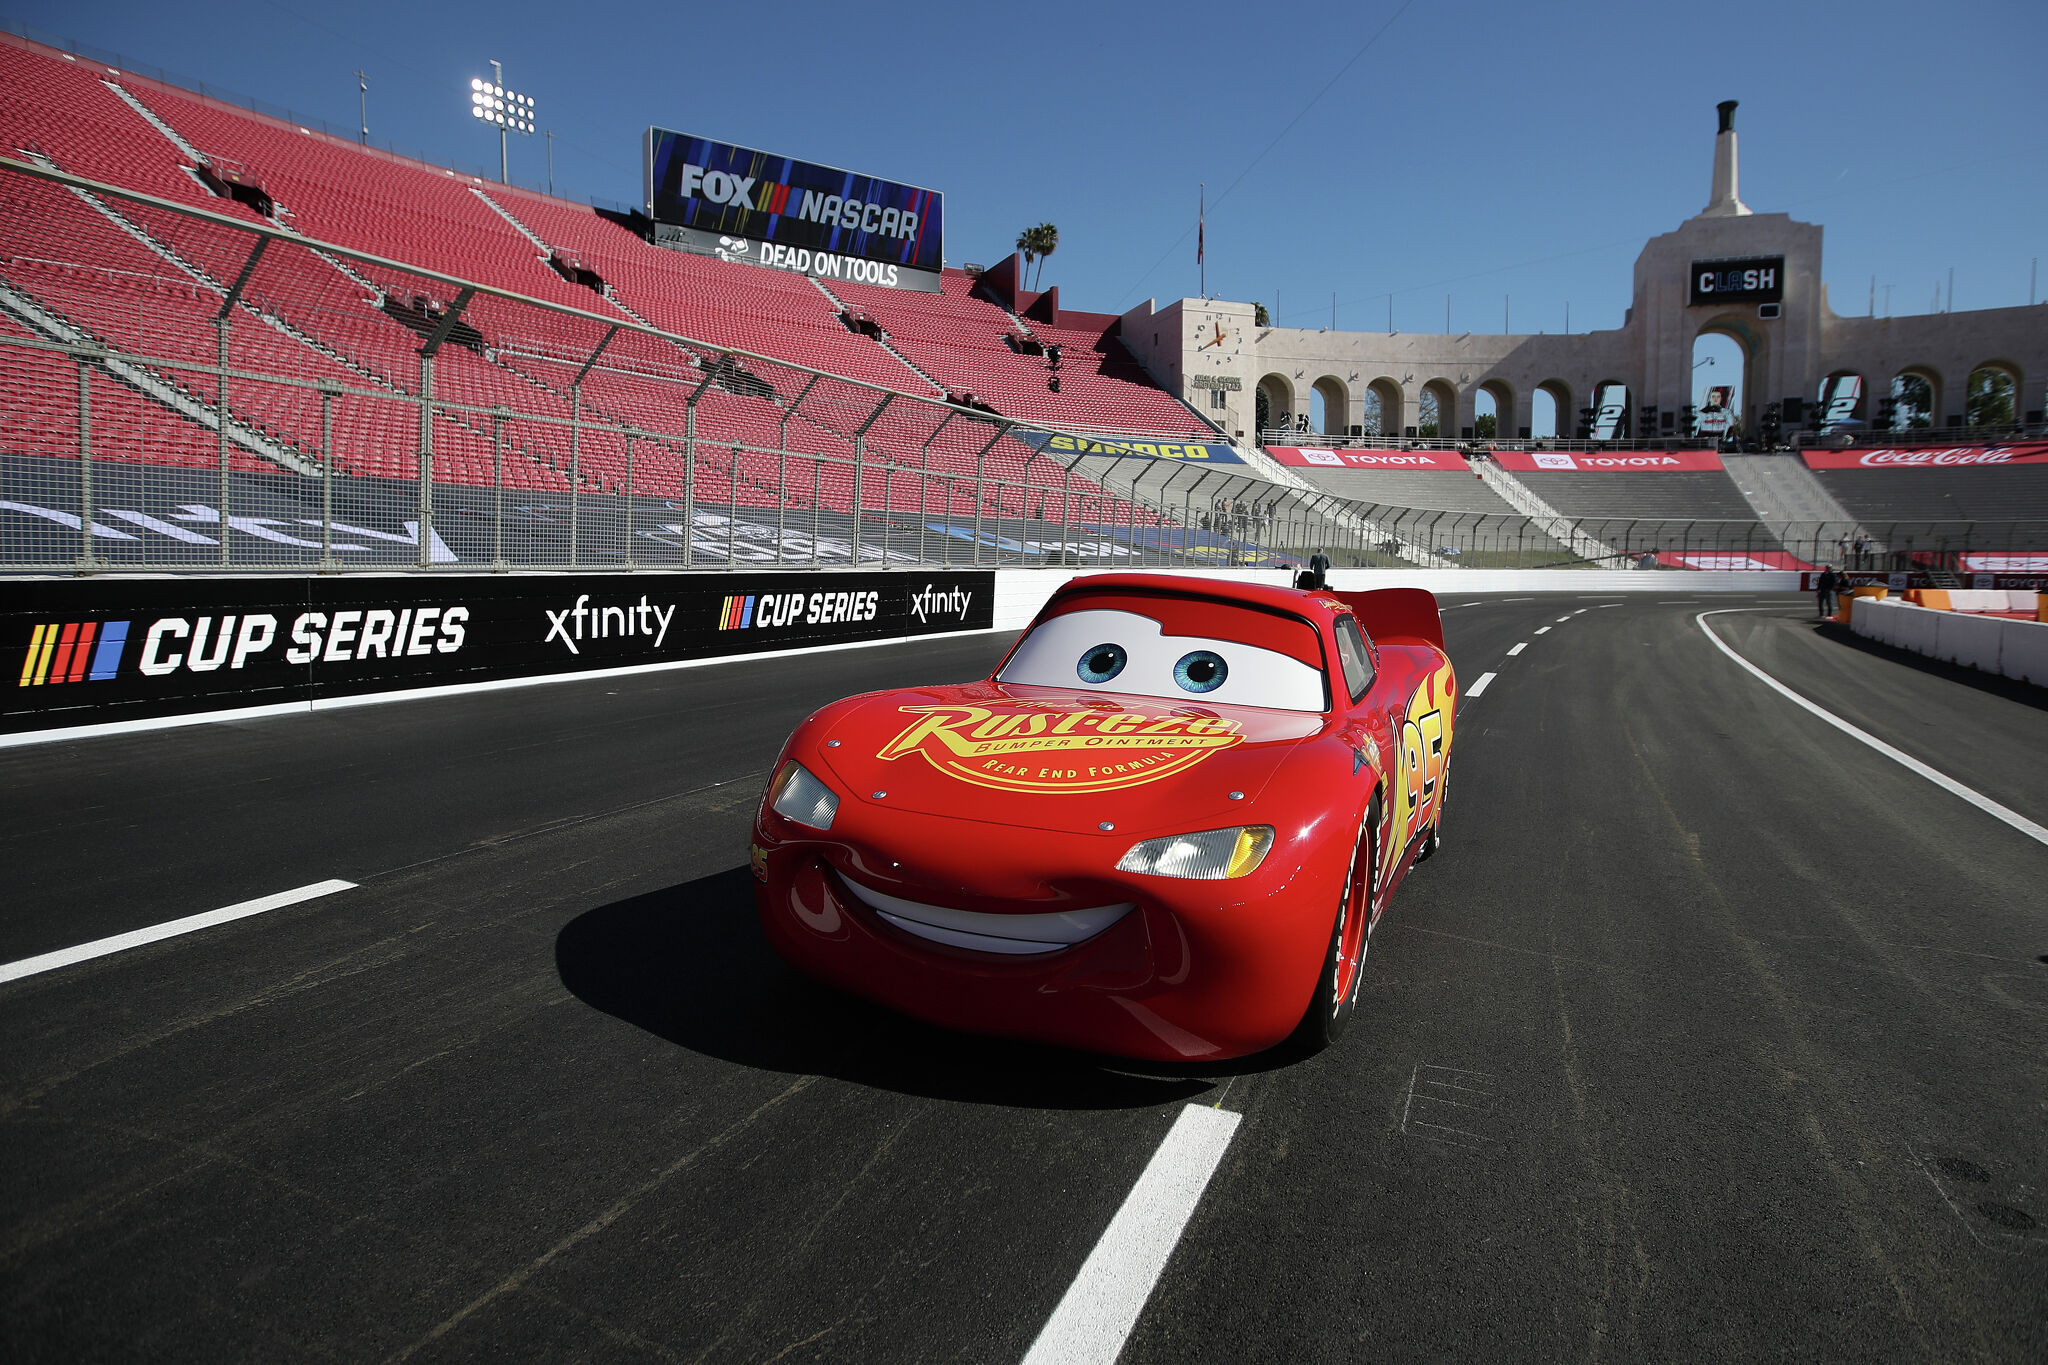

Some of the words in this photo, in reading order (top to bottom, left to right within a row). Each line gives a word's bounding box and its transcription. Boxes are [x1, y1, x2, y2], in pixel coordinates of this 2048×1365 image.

[680, 163, 757, 211] FOX
[799, 189, 919, 242] NASCAR
[760, 241, 811, 272] DEAD
[814, 252, 842, 278] ON
[843, 256, 898, 287] TOOLS
[1700, 267, 1775, 293] CLASH
[1600, 405, 1625, 426] 2
[1050, 435, 1210, 459] SUNOCO
[1344, 454, 1436, 466] TOYOTA
[1580, 456, 1681, 468] TOYOTA
[756, 594, 804, 628] CUP
[806, 590, 879, 625] SERIES
[910, 583, 972, 624] xfinity
[544, 594, 676, 655] xfinity
[139, 612, 276, 677] CUP
[285, 606, 471, 665] SERIES
[974, 738, 1070, 753] BUMPER
[1085, 736, 1208, 747] OINTMENT
[982, 758, 1027, 776] REAR
[1038, 767, 1077, 779] END
[1089, 751, 1176, 778] FORMULA
[1402, 709, 1443, 849] 95
